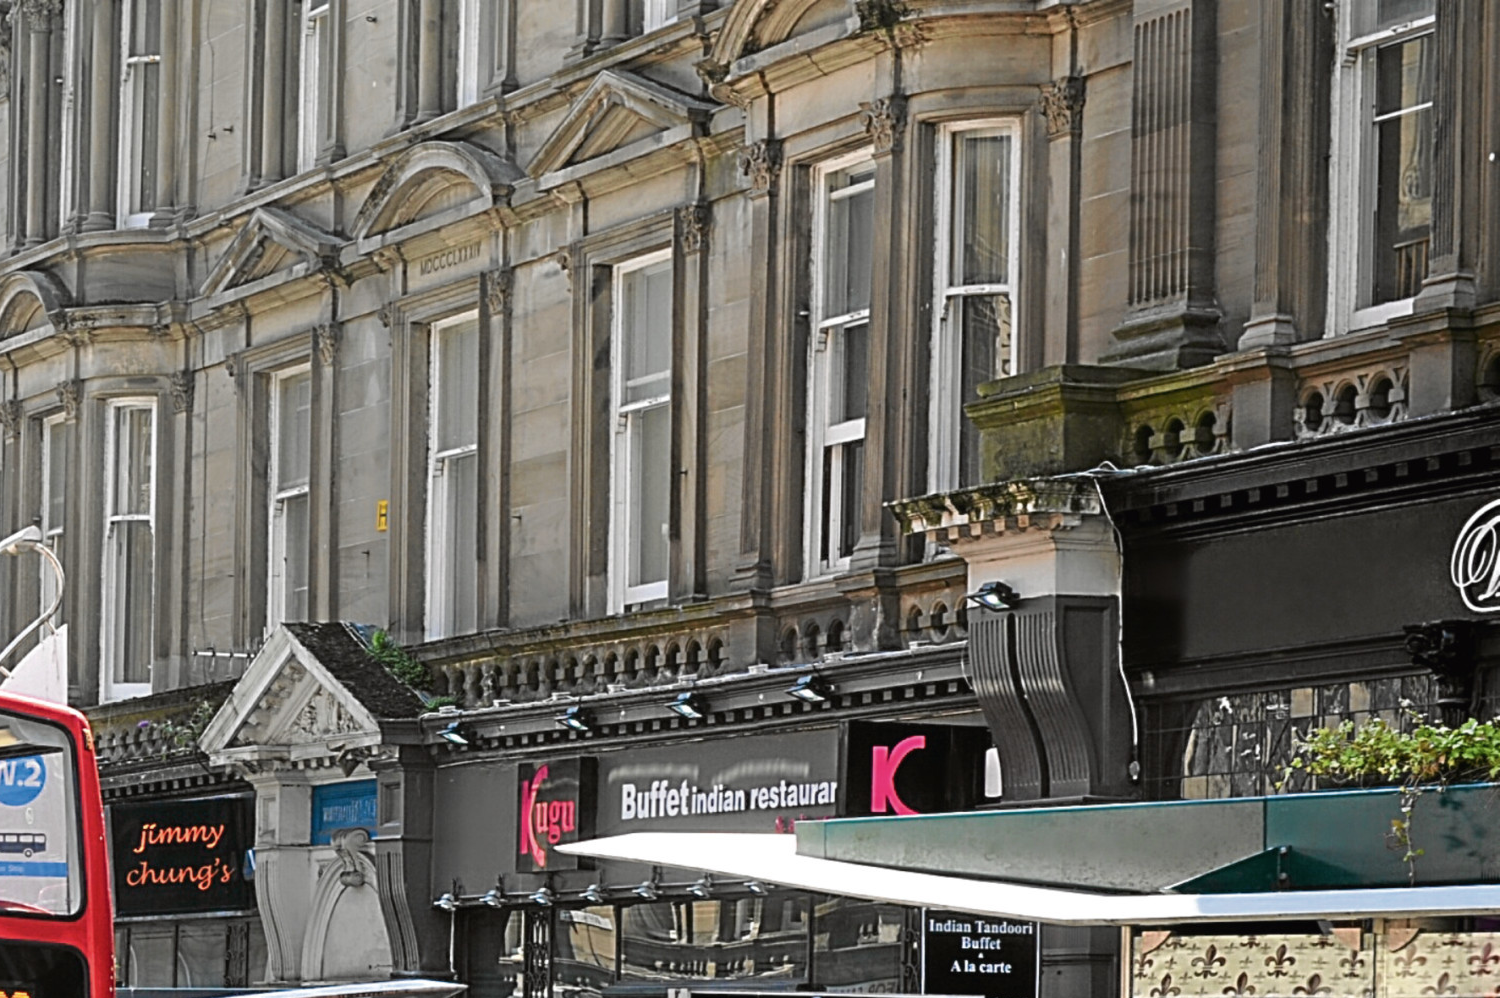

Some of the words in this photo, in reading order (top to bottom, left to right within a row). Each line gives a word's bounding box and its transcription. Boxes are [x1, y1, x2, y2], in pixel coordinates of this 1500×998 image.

[621, 778, 690, 820] Buffet
[691, 785, 745, 815] indian
[520, 764, 575, 868] Kugu
[133, 822, 225, 854] jimmy
[126, 857, 236, 891] chung's
[929, 919, 972, 933] Indian
[974, 920, 1033, 935] Tandoori
[961, 936, 1001, 950] Buffet
[950, 960, 961, 973] A
[964, 960, 976, 973] la
[979, 961, 1012, 973] carte
